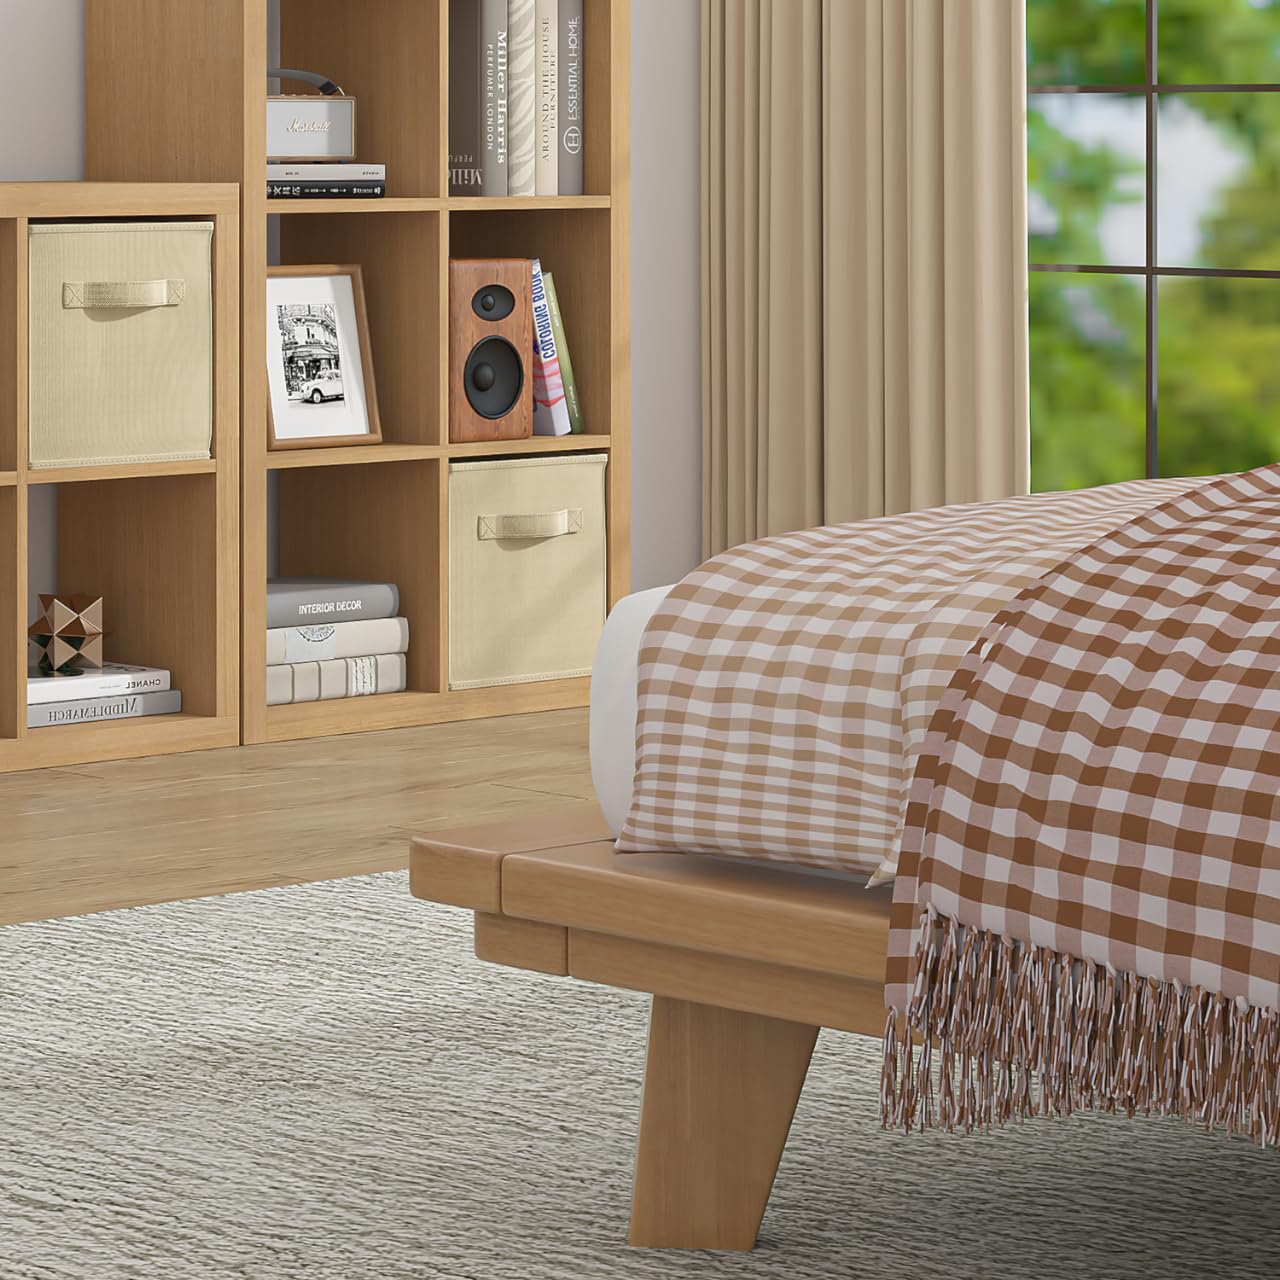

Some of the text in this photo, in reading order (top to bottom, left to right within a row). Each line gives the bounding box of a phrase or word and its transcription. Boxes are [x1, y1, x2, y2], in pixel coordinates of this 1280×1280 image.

[497, 30, 507, 164] Miller Harris
[568, 16, 577, 120] ESSENTIAL HOME
[299, 600, 361, 614] INTERIOR DECOR
